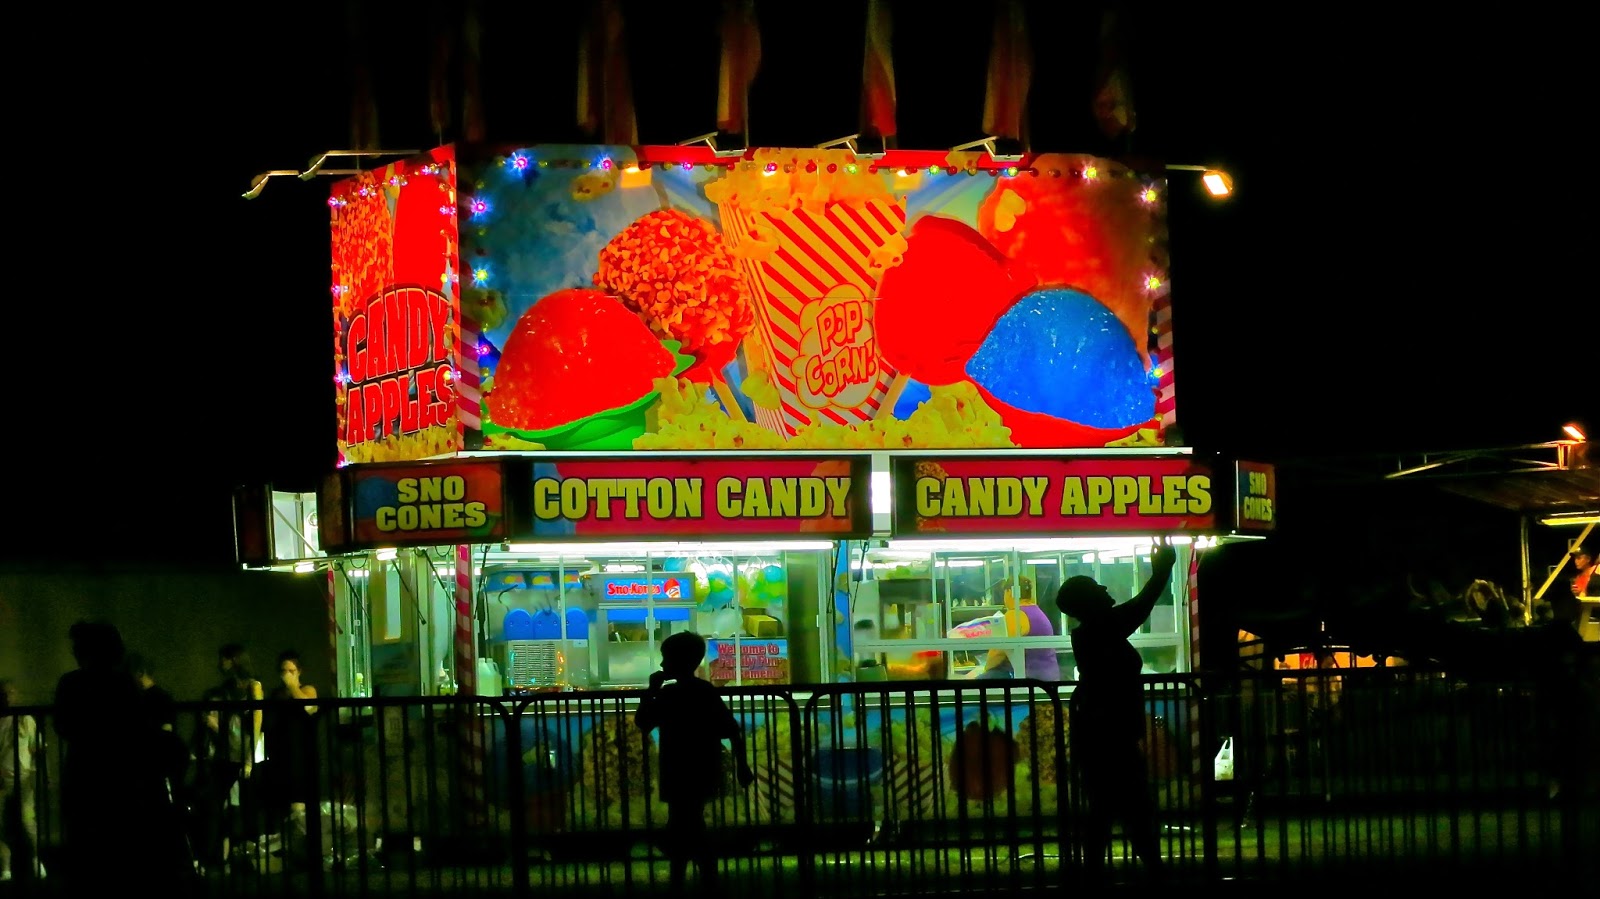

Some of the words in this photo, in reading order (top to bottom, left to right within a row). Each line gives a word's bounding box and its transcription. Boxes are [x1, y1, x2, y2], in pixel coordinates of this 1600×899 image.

[347, 287, 450, 385] CANDY
[816, 301, 863, 356] POP
[805, 337, 877, 398] CORN!
[346, 364, 455, 448] APPLES
[397, 475, 465, 503] SNO
[533, 477, 703, 519] COTTON
[716, 477, 851, 518] CANDY
[916, 476, 1049, 517] CANDY
[1060, 475, 1212, 516] APPLES
[1249, 471, 1267, 496] SNO
[376, 502, 487, 532] CONES
[1244, 496, 1272, 522] CONES
[718, 643, 766, 655] Welome
